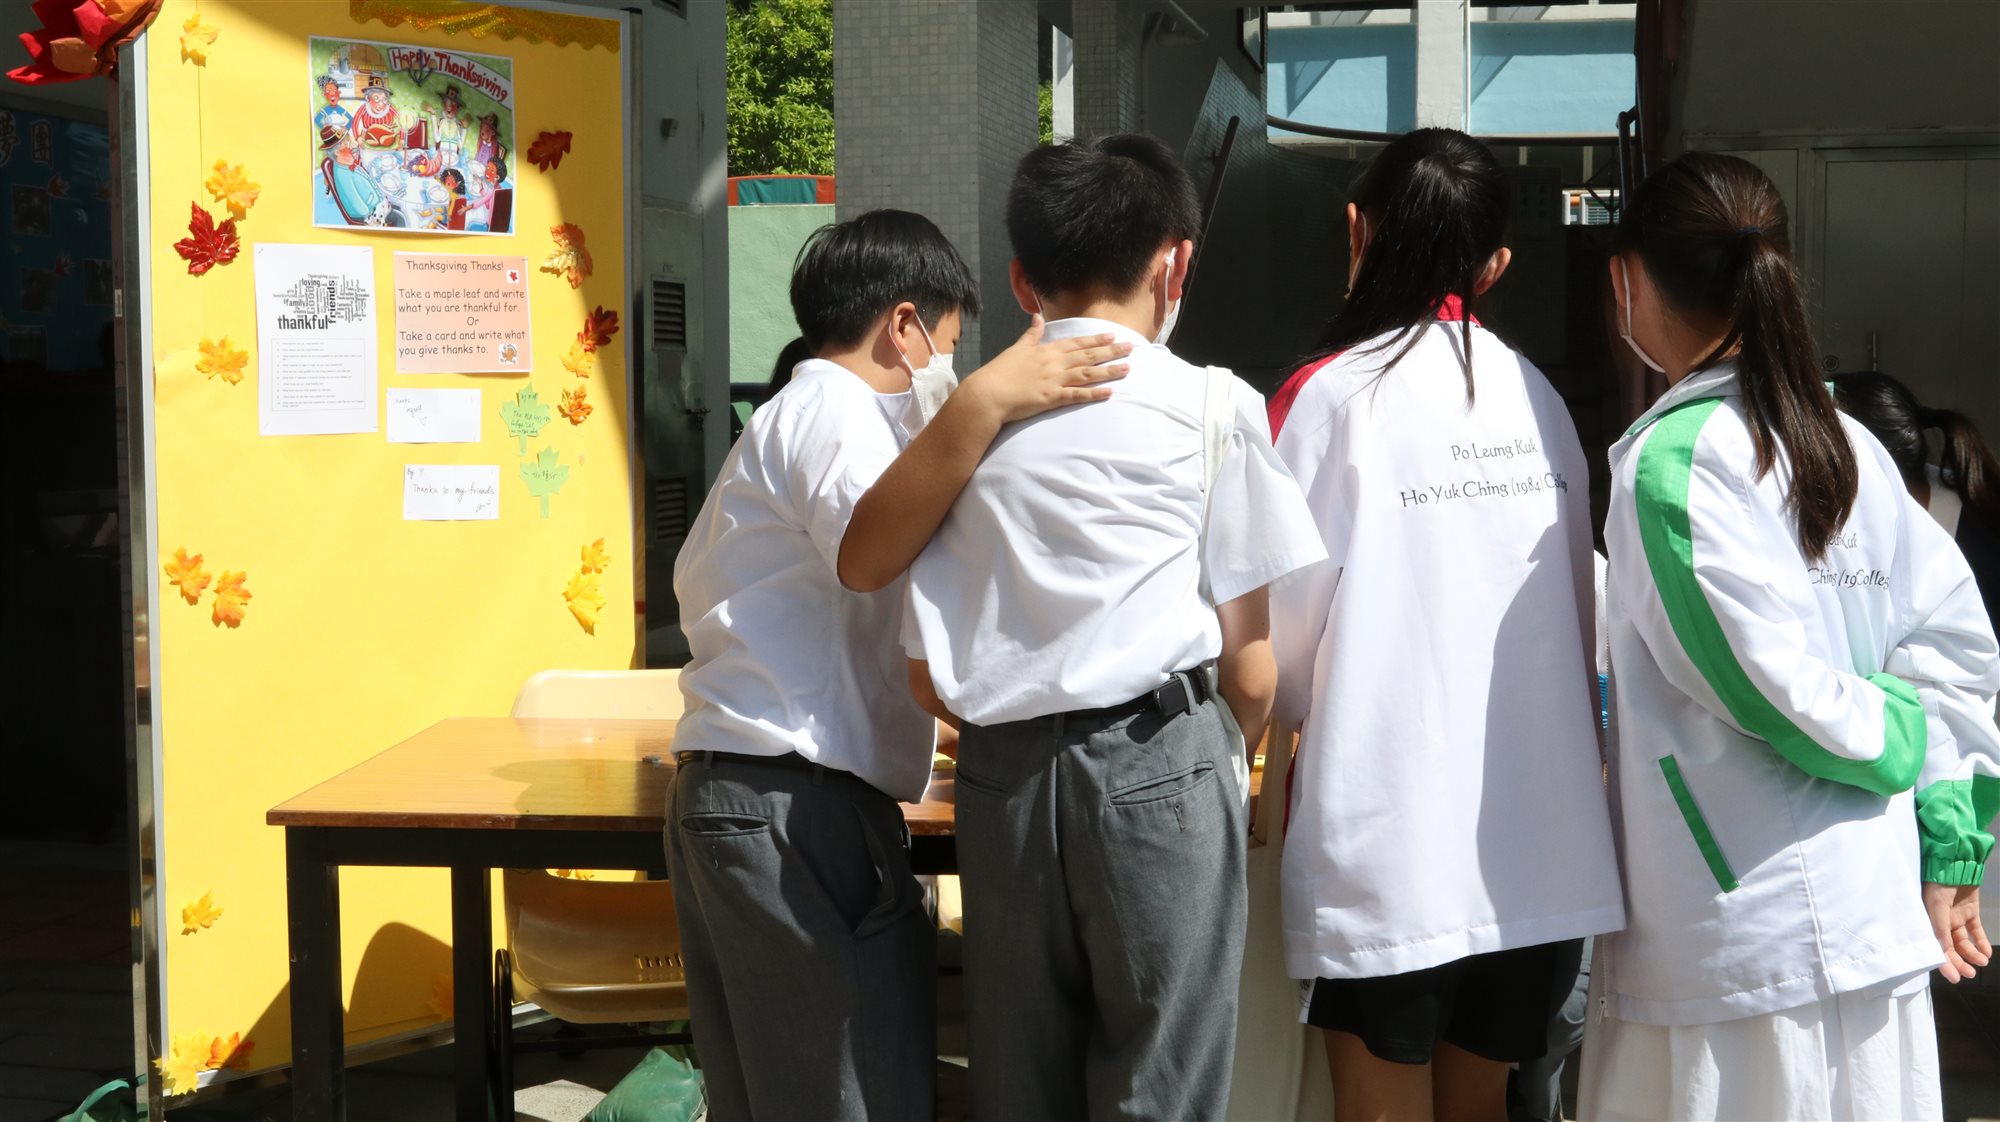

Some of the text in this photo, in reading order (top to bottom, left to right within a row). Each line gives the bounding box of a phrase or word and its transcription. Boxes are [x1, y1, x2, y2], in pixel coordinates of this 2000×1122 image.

[392, 48, 431, 70] Happy
[405, 260, 504, 273] Thanksgiving Thanks!
[301, 278, 320, 287] loving
[327, 280, 336, 323] friends
[398, 289, 422, 299] Take
[433, 288, 461, 301] maple
[463, 288, 481, 298] leaf
[484, 289, 500, 299] and
[502, 290, 525, 299] write
[398, 303, 422, 313] what
[425, 305, 442, 315] you
[463, 302, 501, 312] thankful
[504, 302, 520, 312] for.
[278, 314, 329, 330] thankful
[466, 316, 480, 326] Or
[399, 331, 423, 341] Take
[435, 330, 457, 340] card
[460, 330, 476, 340] and
[478, 331, 502, 340] write
[504, 329, 526, 339] what
[399, 344, 488, 358] you give thanks to.
[1451, 438, 1539, 461] Po Leung Kuk
[413, 483, 438, 494] Thanks
[468, 481, 495, 495] friends
[1400, 489, 1428, 508] Ho
[1429, 483, 1461, 505] Yuk
[1462, 481, 1508, 498] Ching
[1856, 568, 1890, 591] Colleg
